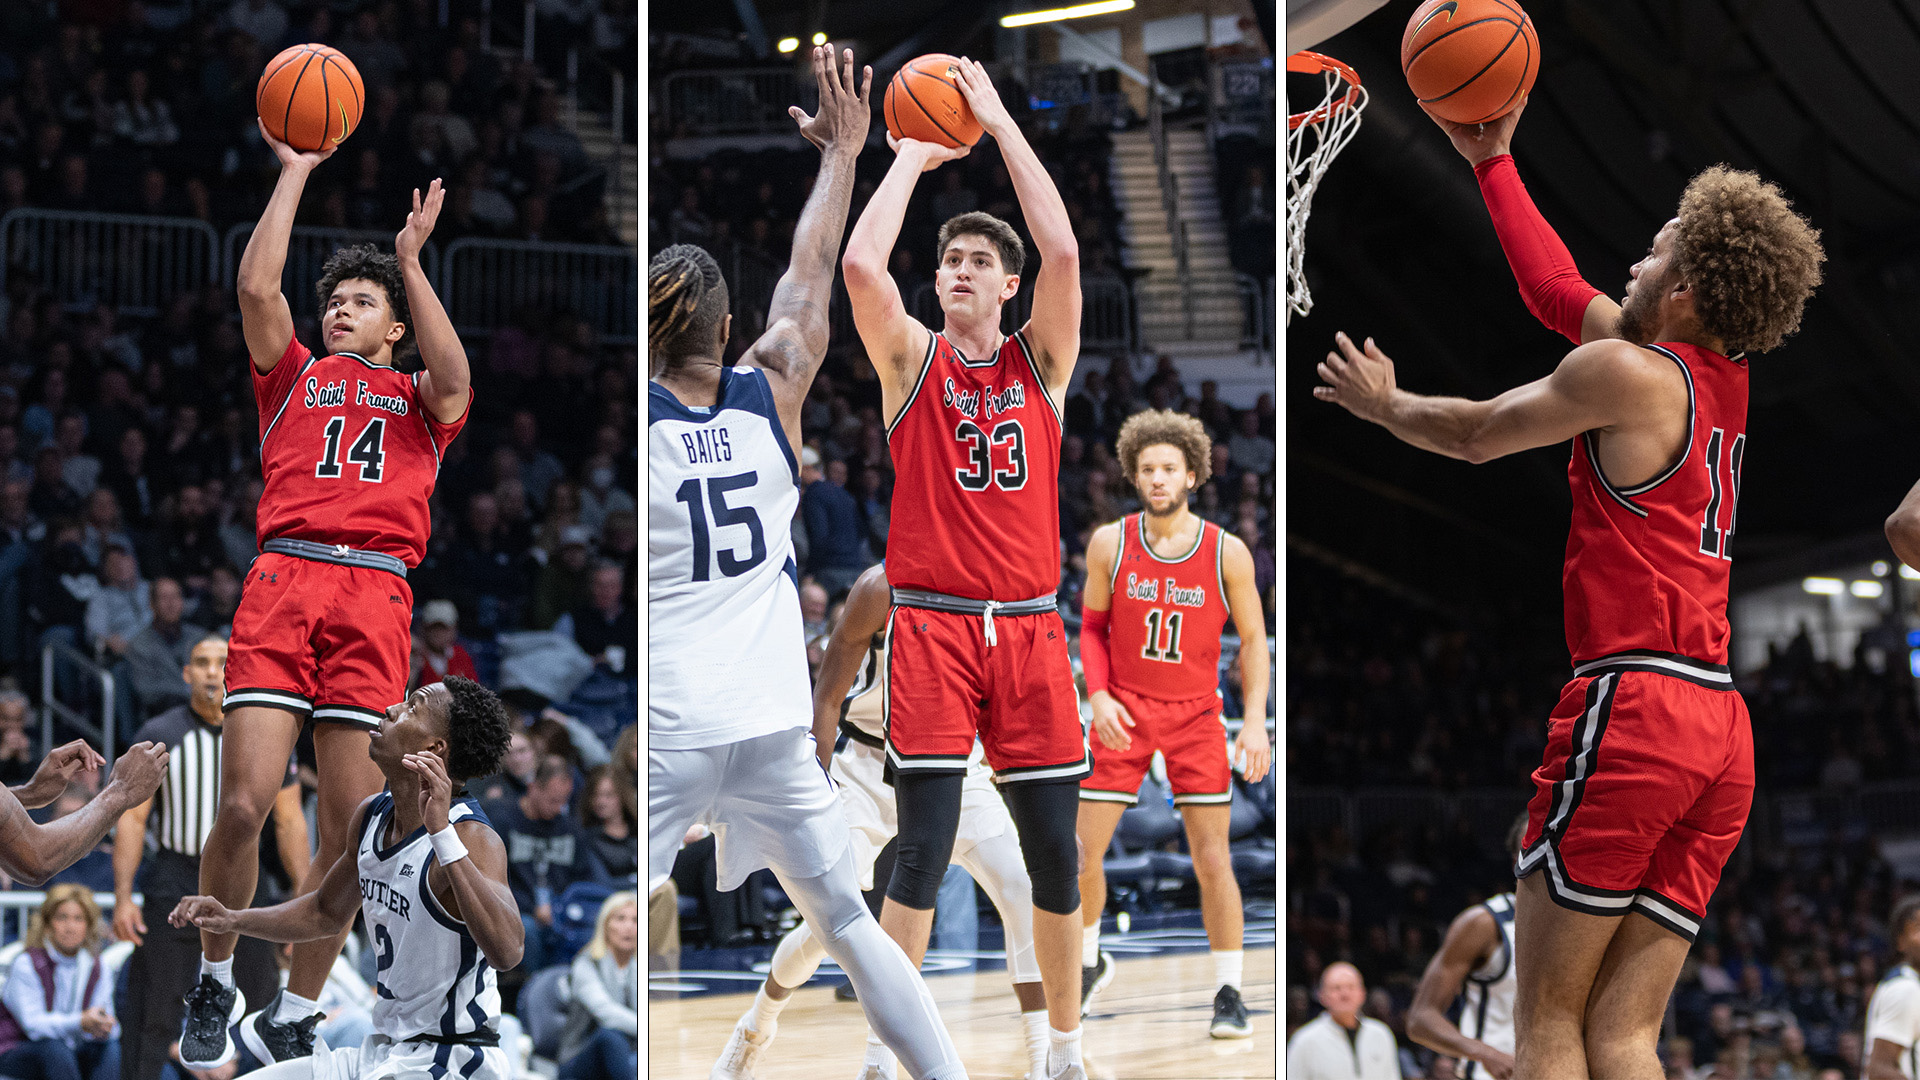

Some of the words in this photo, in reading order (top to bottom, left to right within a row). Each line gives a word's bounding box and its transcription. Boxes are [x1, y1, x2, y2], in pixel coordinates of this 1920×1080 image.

[305, 377, 346, 408] Saint
[356, 379, 408, 416] Francis
[315, 416, 387, 483] 14
[681, 428, 732, 464] BATES
[955, 419, 1028, 491] 33
[676, 471, 767, 581] 15
[1127, 572, 1158, 602] Saint
[1165, 577, 1205, 607] Francis
[1141, 607, 1183, 664] 11
[360, 878, 411, 922] BUTLER
[374, 923, 397, 1000] 2
